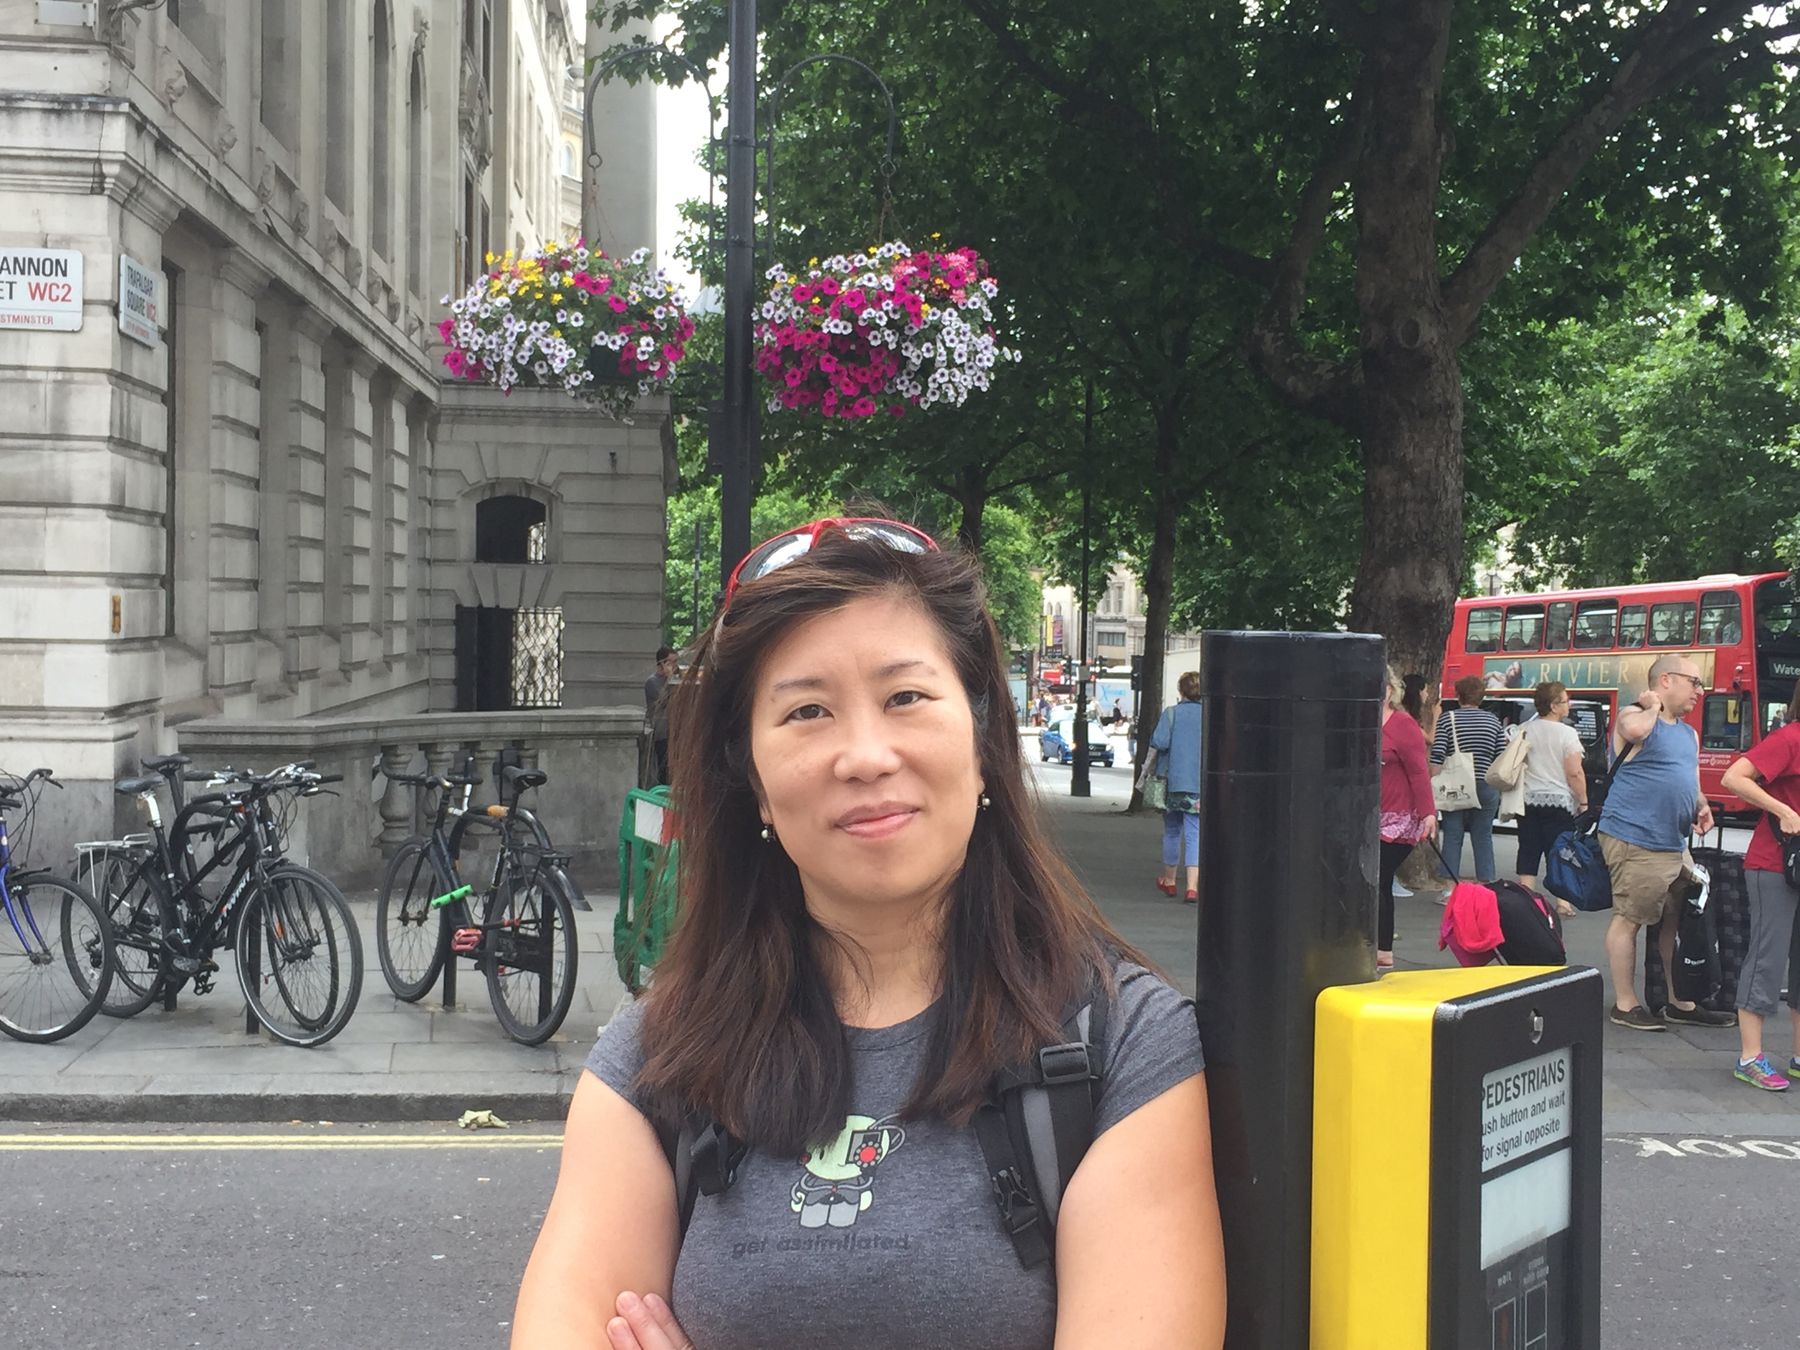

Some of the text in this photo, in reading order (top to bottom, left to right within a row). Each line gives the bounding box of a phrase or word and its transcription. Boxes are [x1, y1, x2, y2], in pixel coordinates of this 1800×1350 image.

[0, 256, 68, 277] ANNON
[28, 281, 72, 302] WC2
[1500, 1107, 1529, 1129] button
[1530, 1096, 1546, 1117] and
[1548, 1090, 1565, 1109] wait
[1496, 1130, 1523, 1158] signal
[1524, 1118, 1561, 1145] opposite
[1605, 1136, 1800, 1160] OOK
[731, 1237, 767, 1260] get
